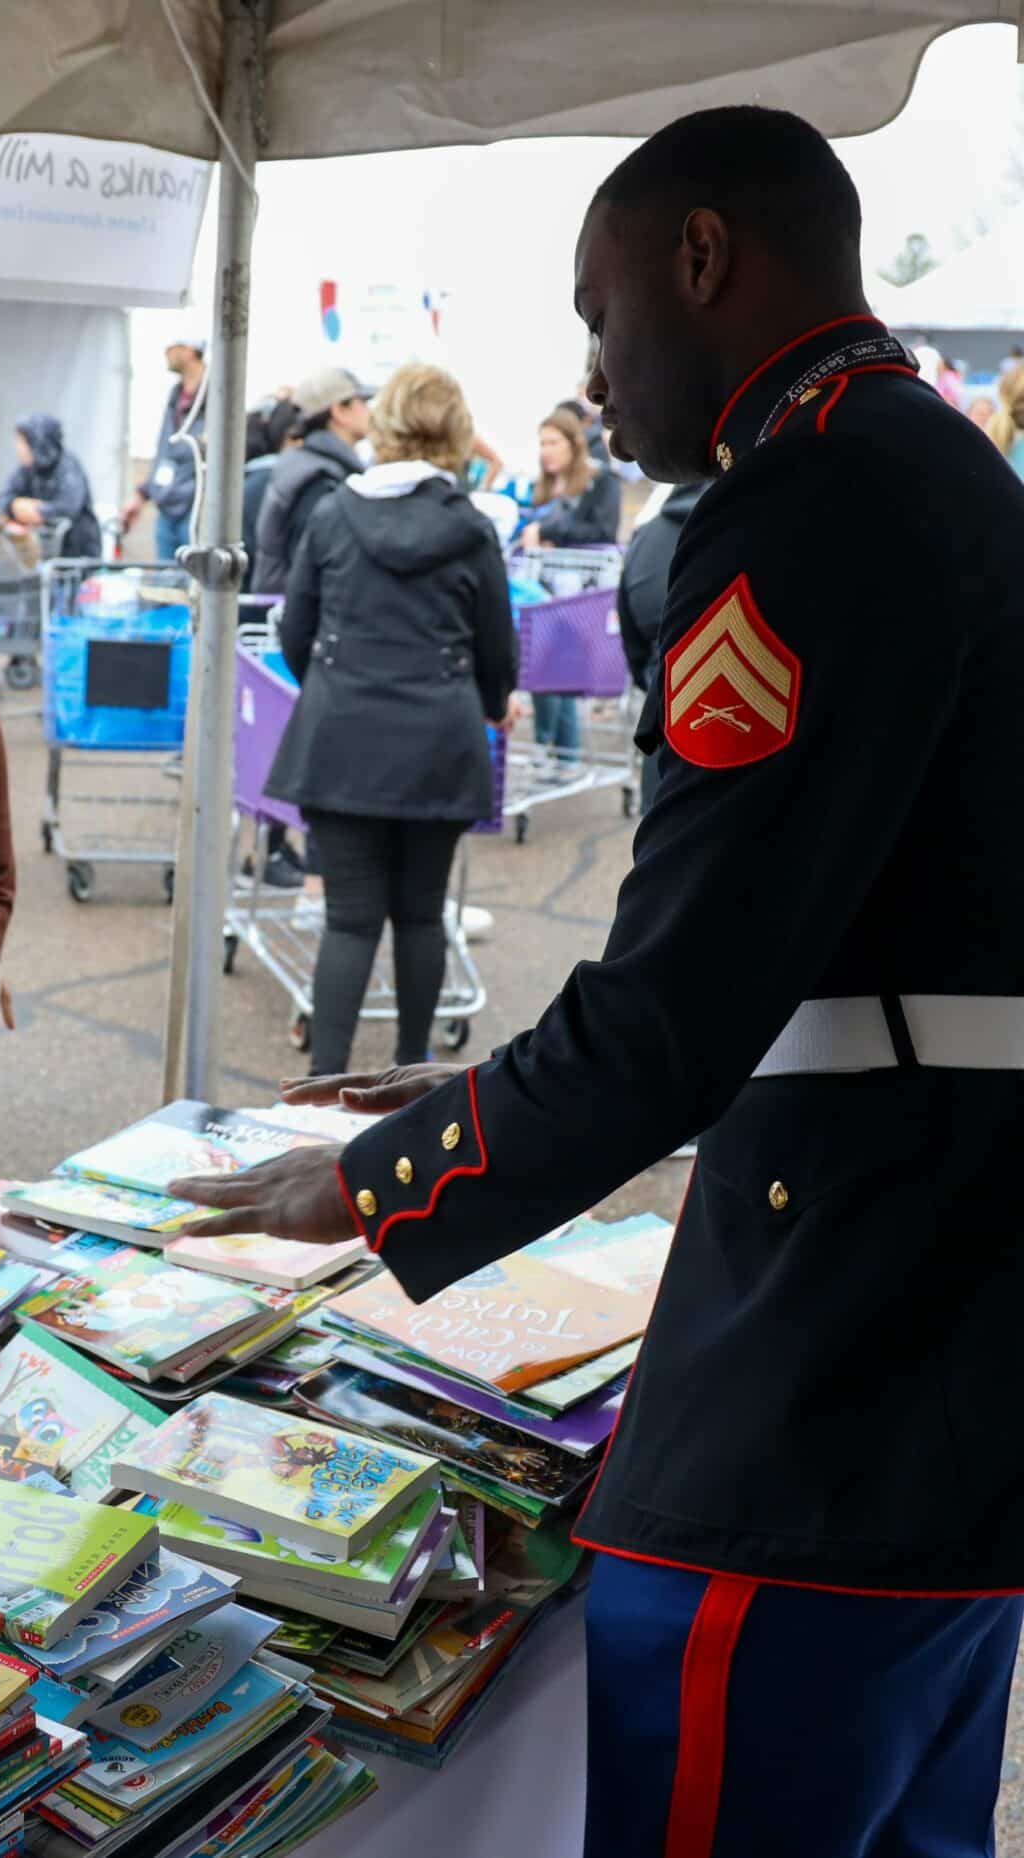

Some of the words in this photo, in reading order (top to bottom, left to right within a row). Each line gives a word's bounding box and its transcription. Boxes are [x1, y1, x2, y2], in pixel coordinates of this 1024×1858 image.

[785, 354, 846, 402] destiny
[368, 1305, 395, 1321] a
[407, 1311, 516, 1347] Catch
[432, 1289, 584, 1341] Turke
[436, 1344, 513, 1372] How
